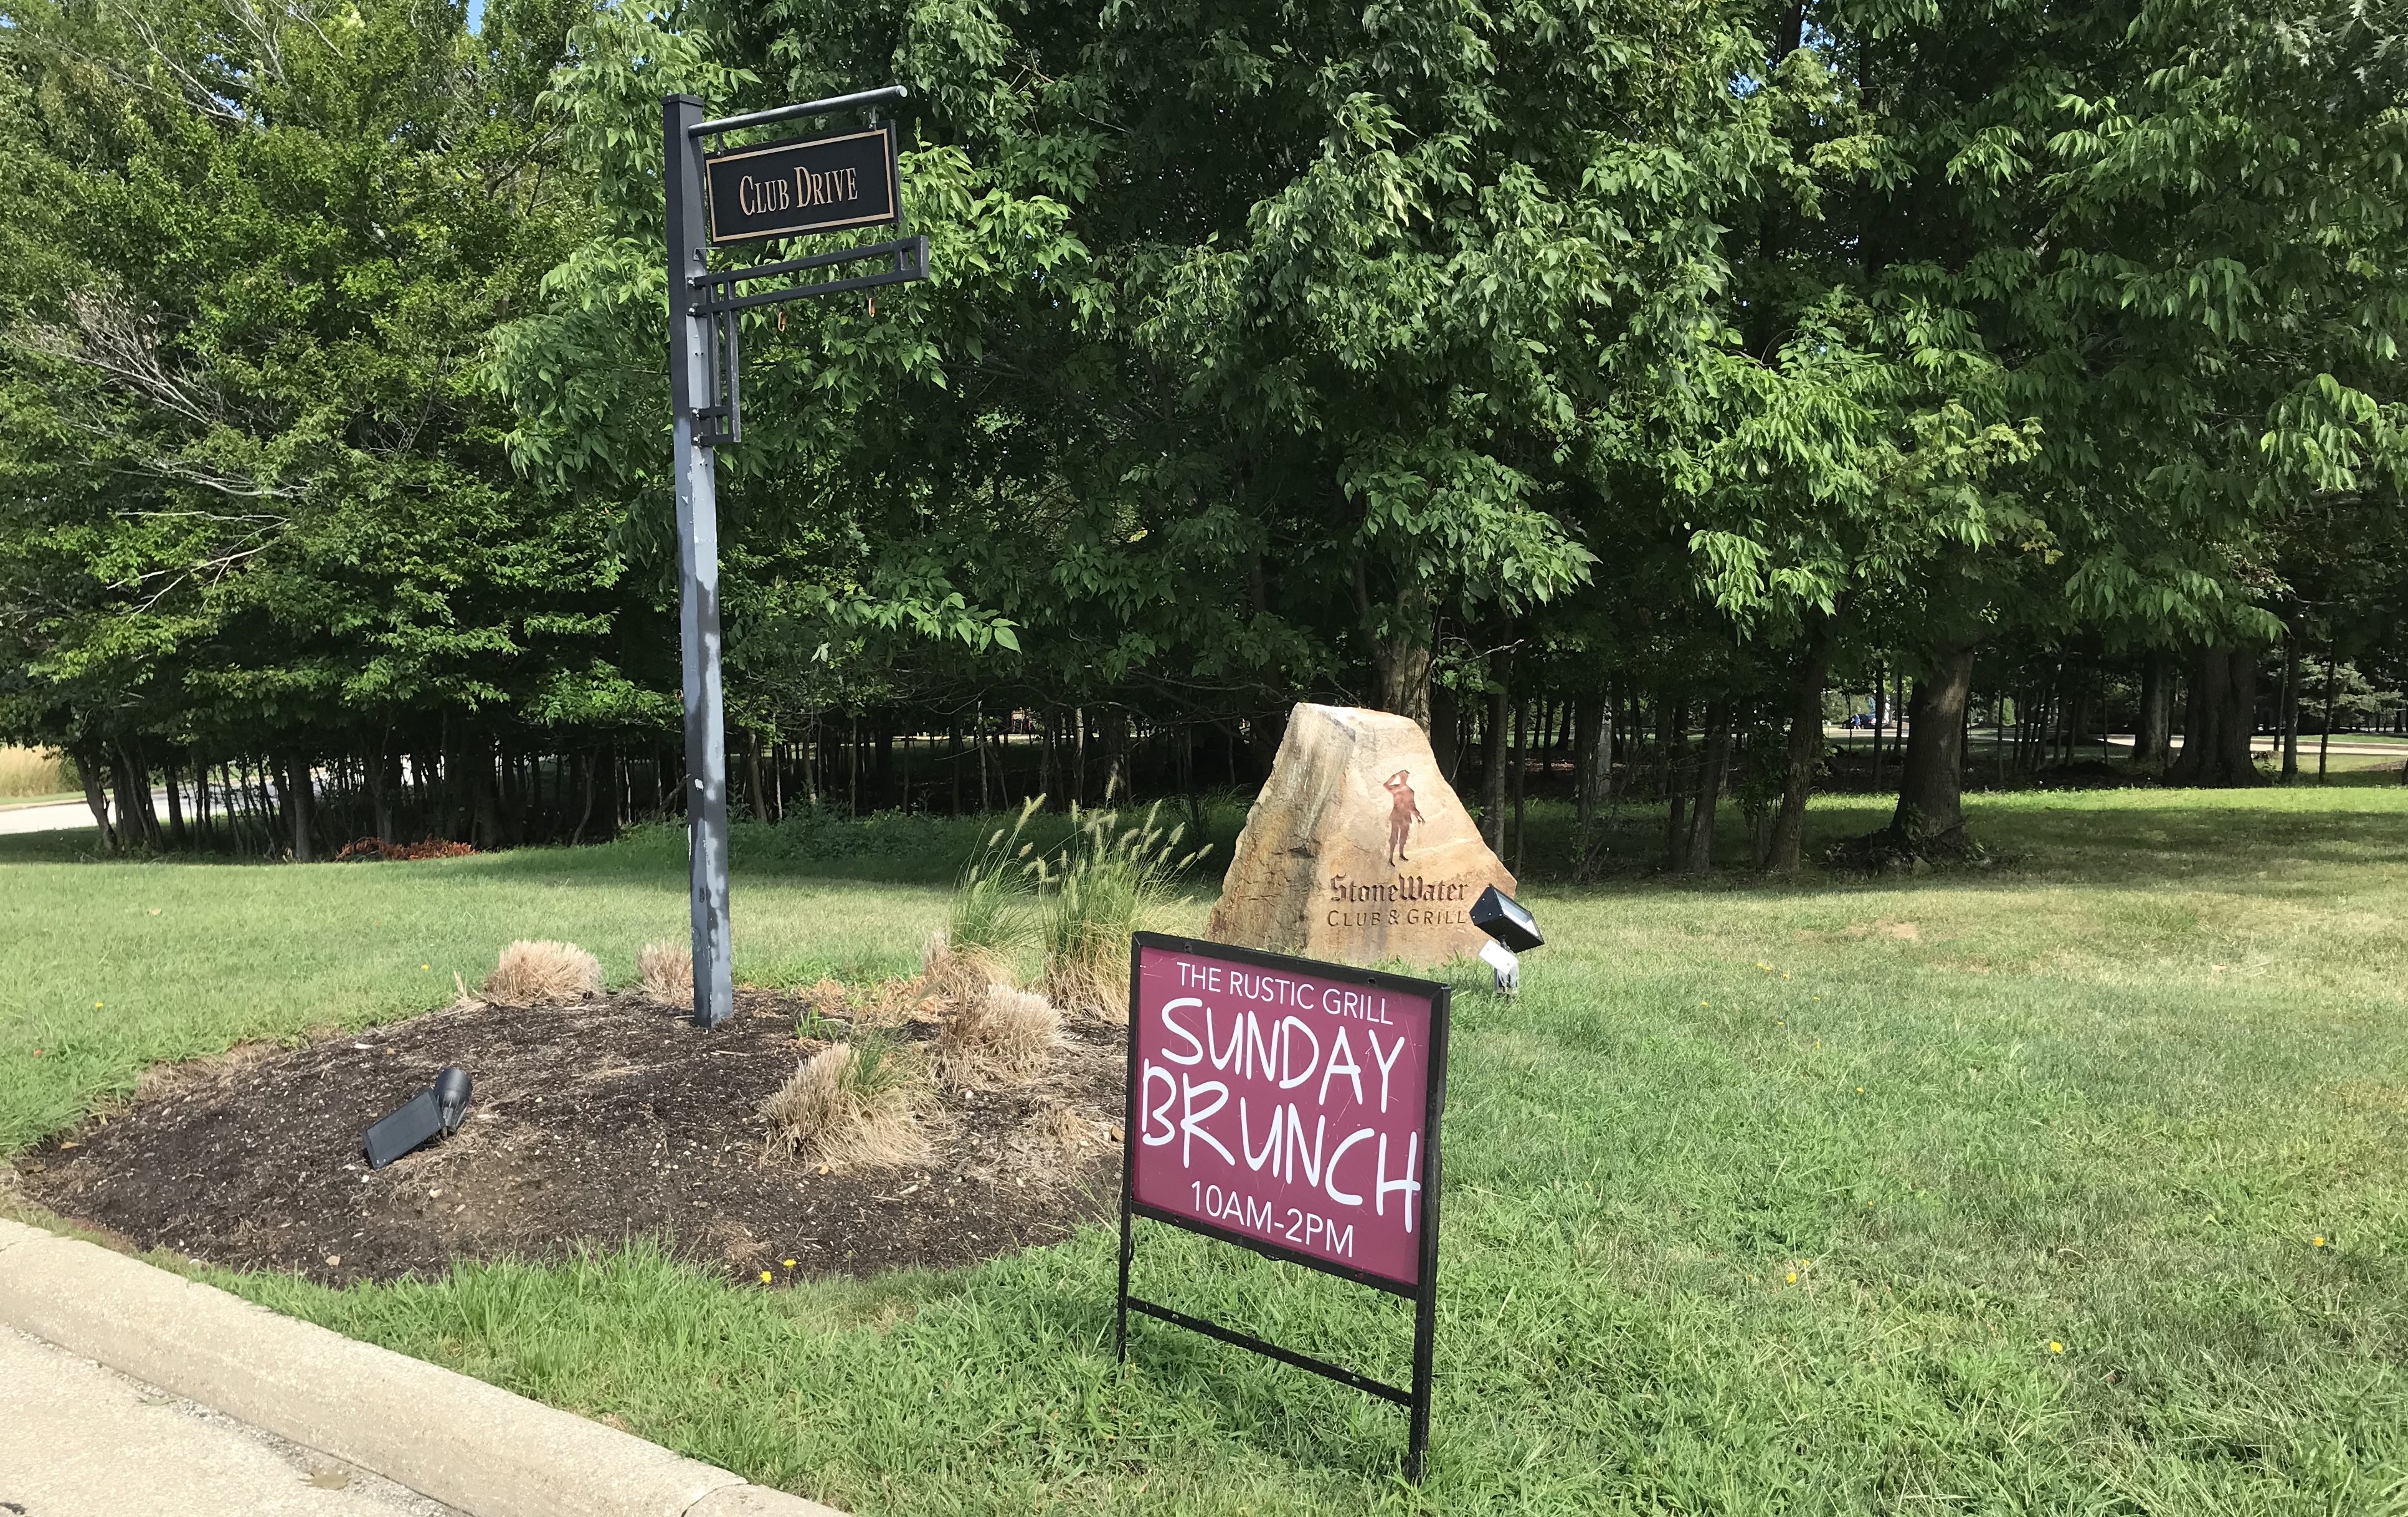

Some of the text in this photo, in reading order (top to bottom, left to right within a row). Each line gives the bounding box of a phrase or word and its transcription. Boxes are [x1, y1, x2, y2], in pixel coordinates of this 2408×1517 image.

[1327, 908, 1467, 926] CLUB & GRILL
[1330, 873, 1469, 903] StoneWater
[1177, 961, 1393, 1025] THE RUSTIC GRILL
[1161, 997, 1405, 1113] SUNDAY
[1141, 1058, 1421, 1233] BRUNCH
[1191, 1181, 1353, 1258] 10AM-2PM
